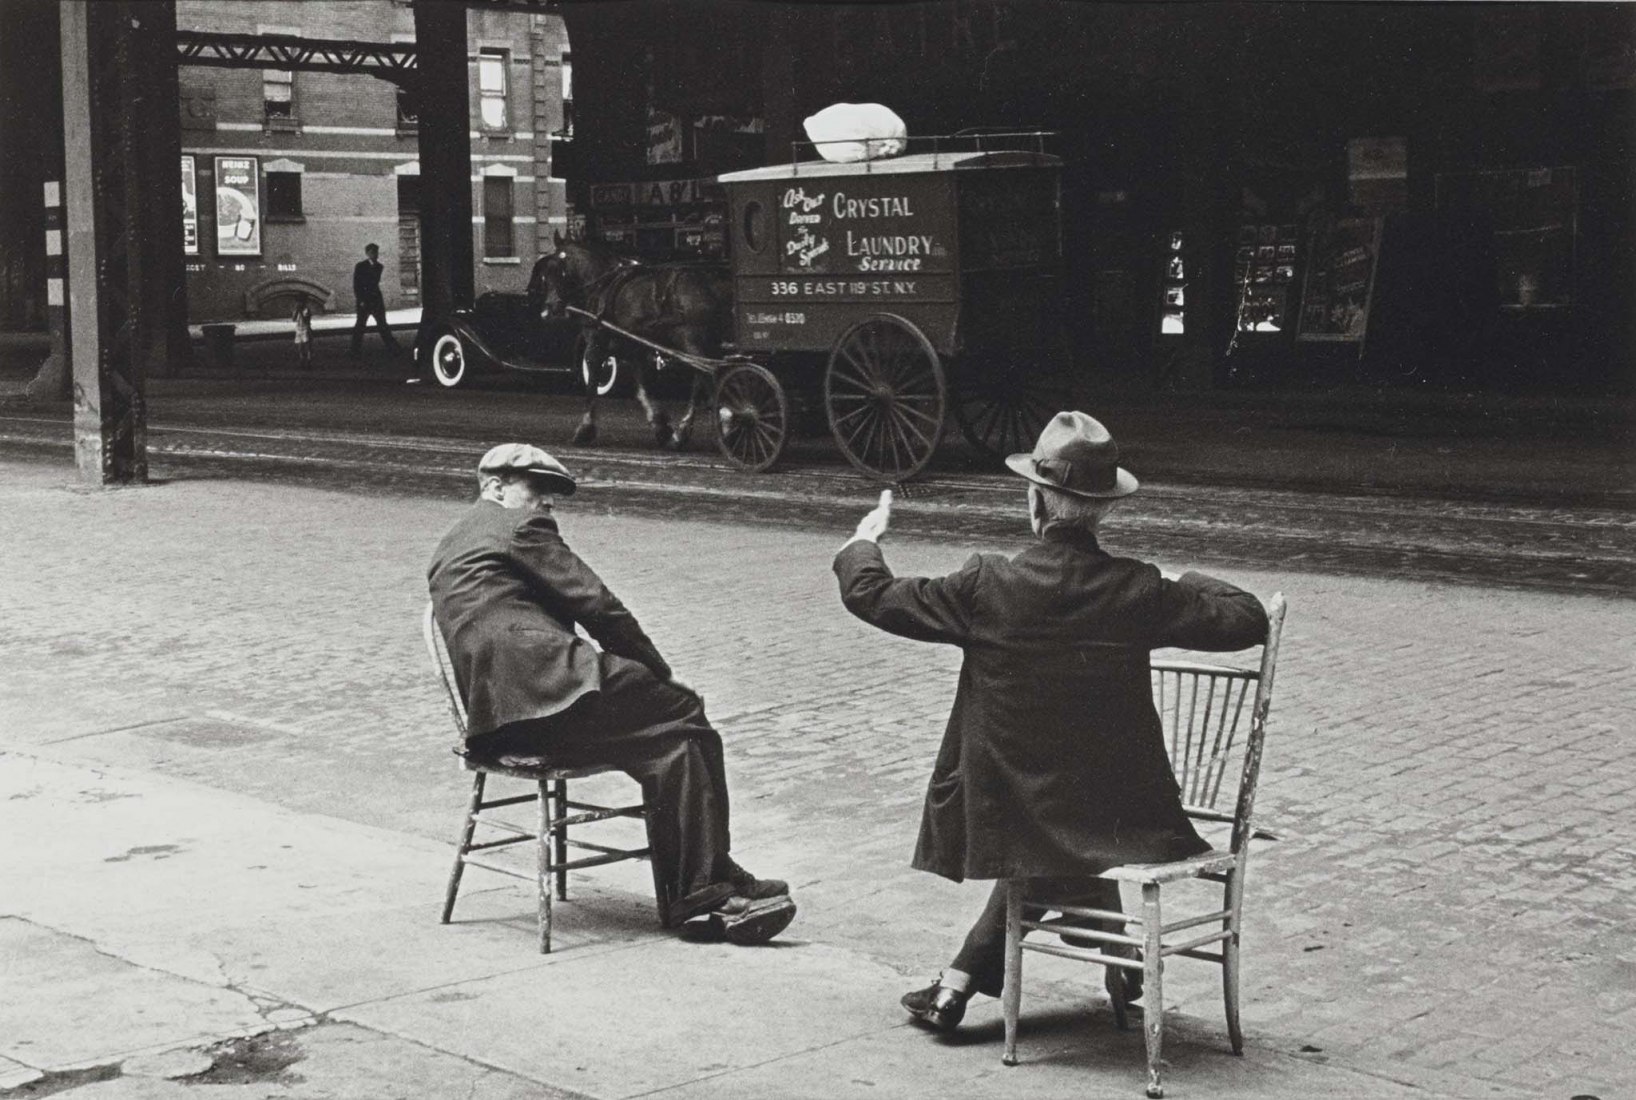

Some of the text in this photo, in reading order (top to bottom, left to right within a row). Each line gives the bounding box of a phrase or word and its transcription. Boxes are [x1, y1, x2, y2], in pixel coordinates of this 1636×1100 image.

[224, 175, 249, 185] SOUP
[858, 256, 922, 271] Service
[770, 281, 799, 295] 336
[803, 281, 847, 295] EAST
